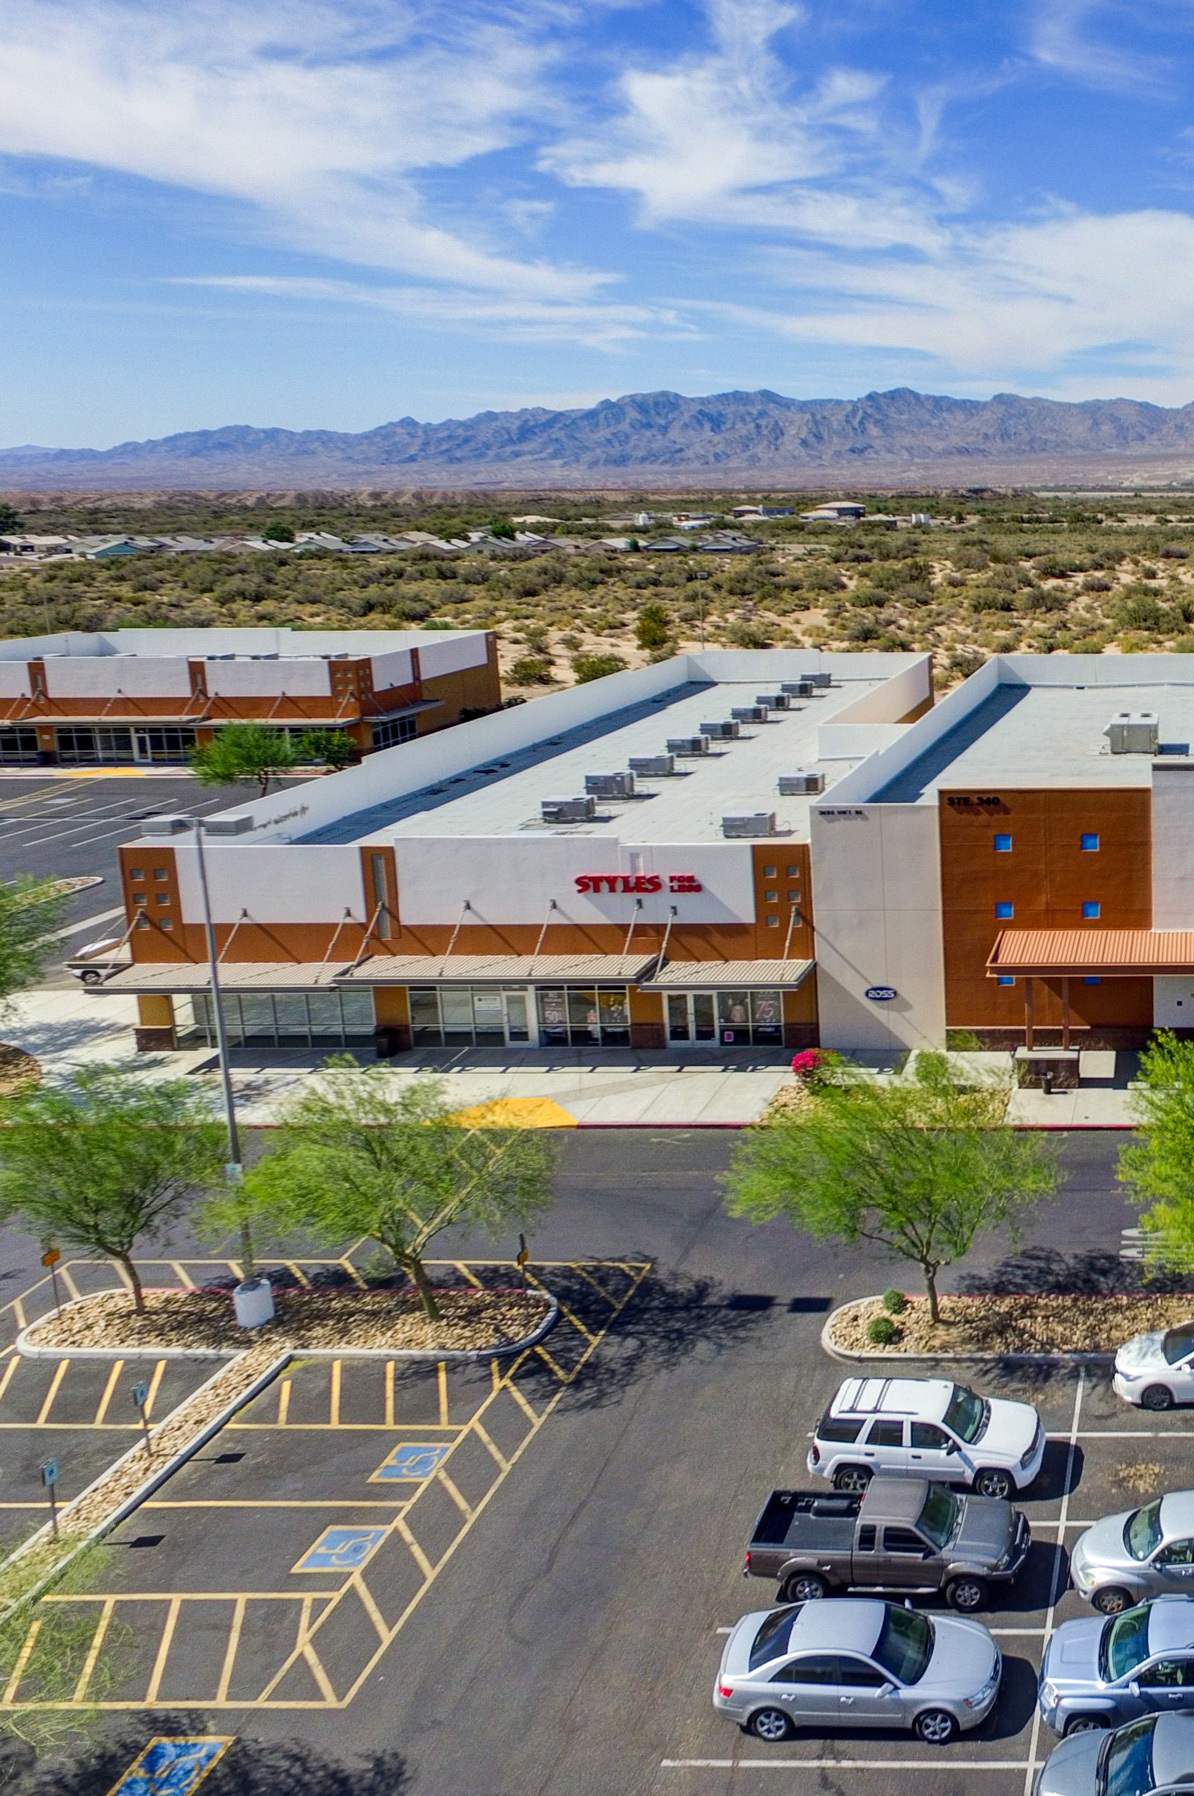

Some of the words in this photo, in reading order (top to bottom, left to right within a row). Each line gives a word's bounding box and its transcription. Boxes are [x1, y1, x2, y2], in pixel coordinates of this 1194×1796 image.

[947, 796, 974, 807] STE.
[976, 796, 1001, 807] 340
[575, 874, 662, 894] STYLES
[868, 990, 895, 998] ROSS
